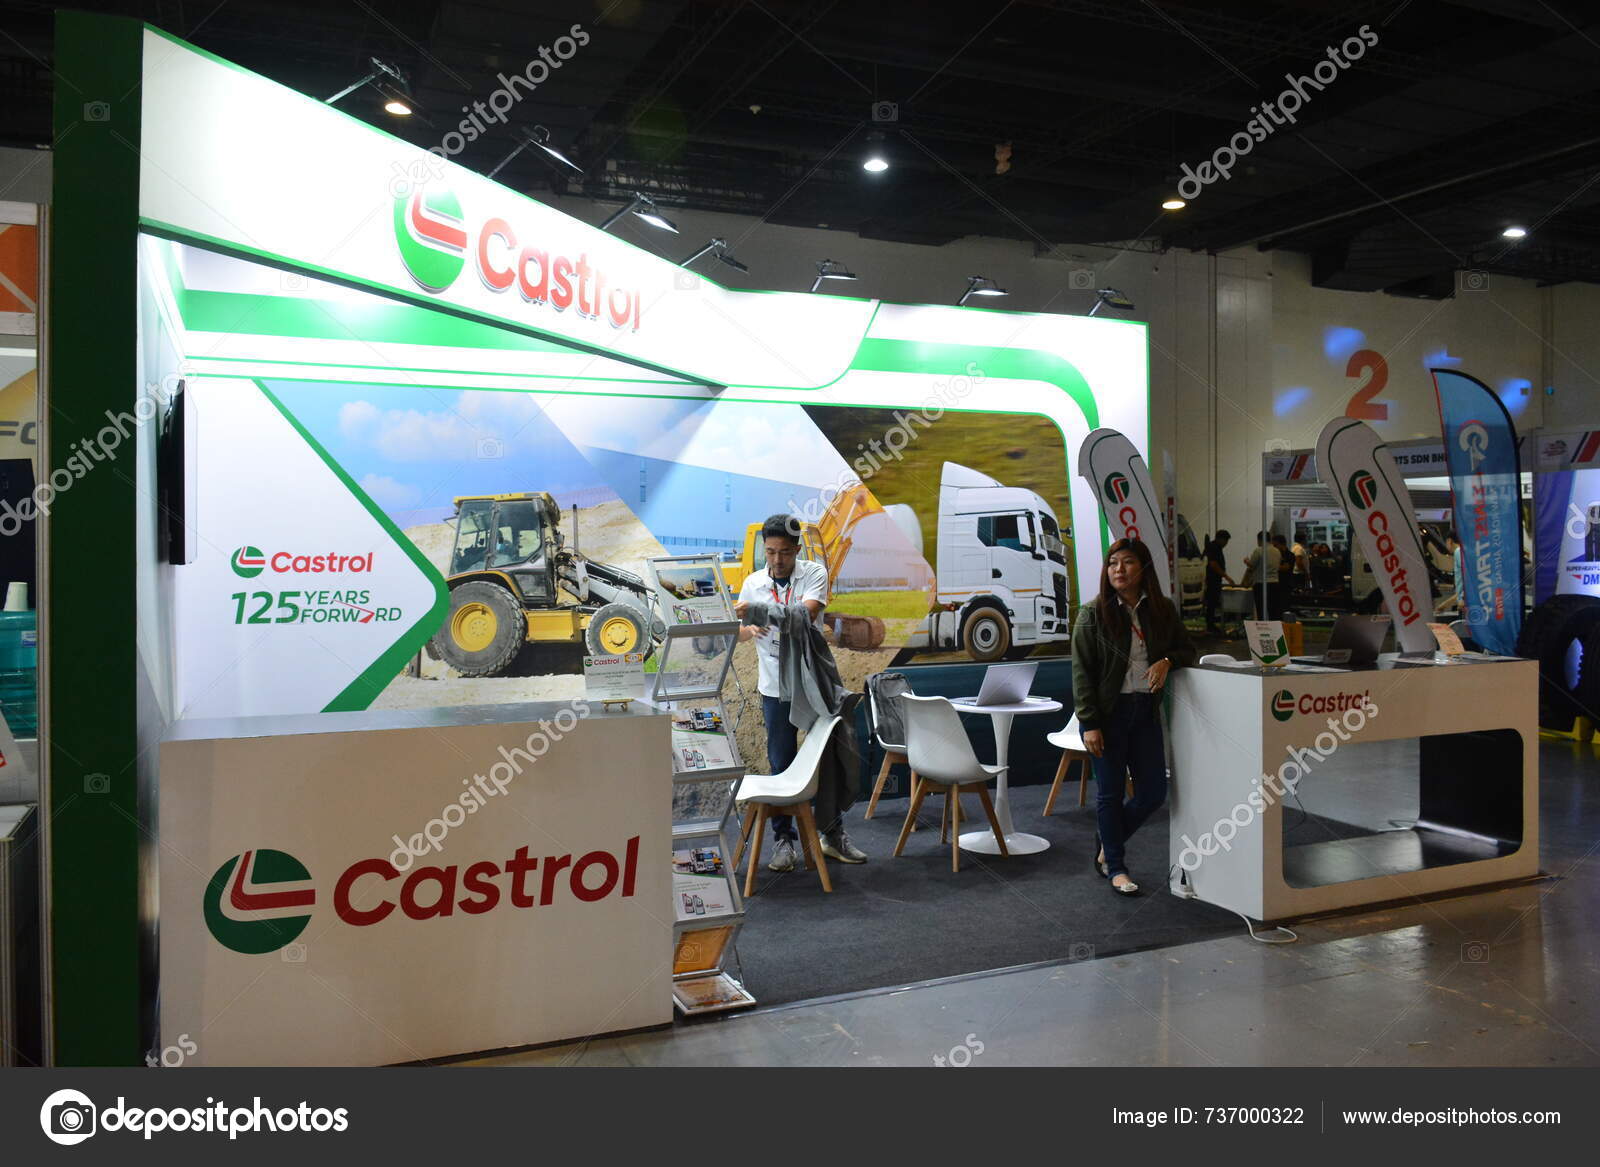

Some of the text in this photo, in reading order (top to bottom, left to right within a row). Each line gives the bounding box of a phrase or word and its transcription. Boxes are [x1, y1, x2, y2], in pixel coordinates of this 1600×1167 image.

[477, 217, 641, 332] Castrol
[1345, 349, 1388, 420] 2
[1411, 454, 1429, 464] SDN
[1432, 453, 1448, 463] BH
[271, 551, 374, 574] Castrol
[1367, 510, 1421, 627] Castrol
[231, 590, 371, 625] 125 YEARS
[594, 658, 620, 666] Castrol
[1298, 689, 1371, 715] Castrol
[333, 835, 641, 927] Castrol
